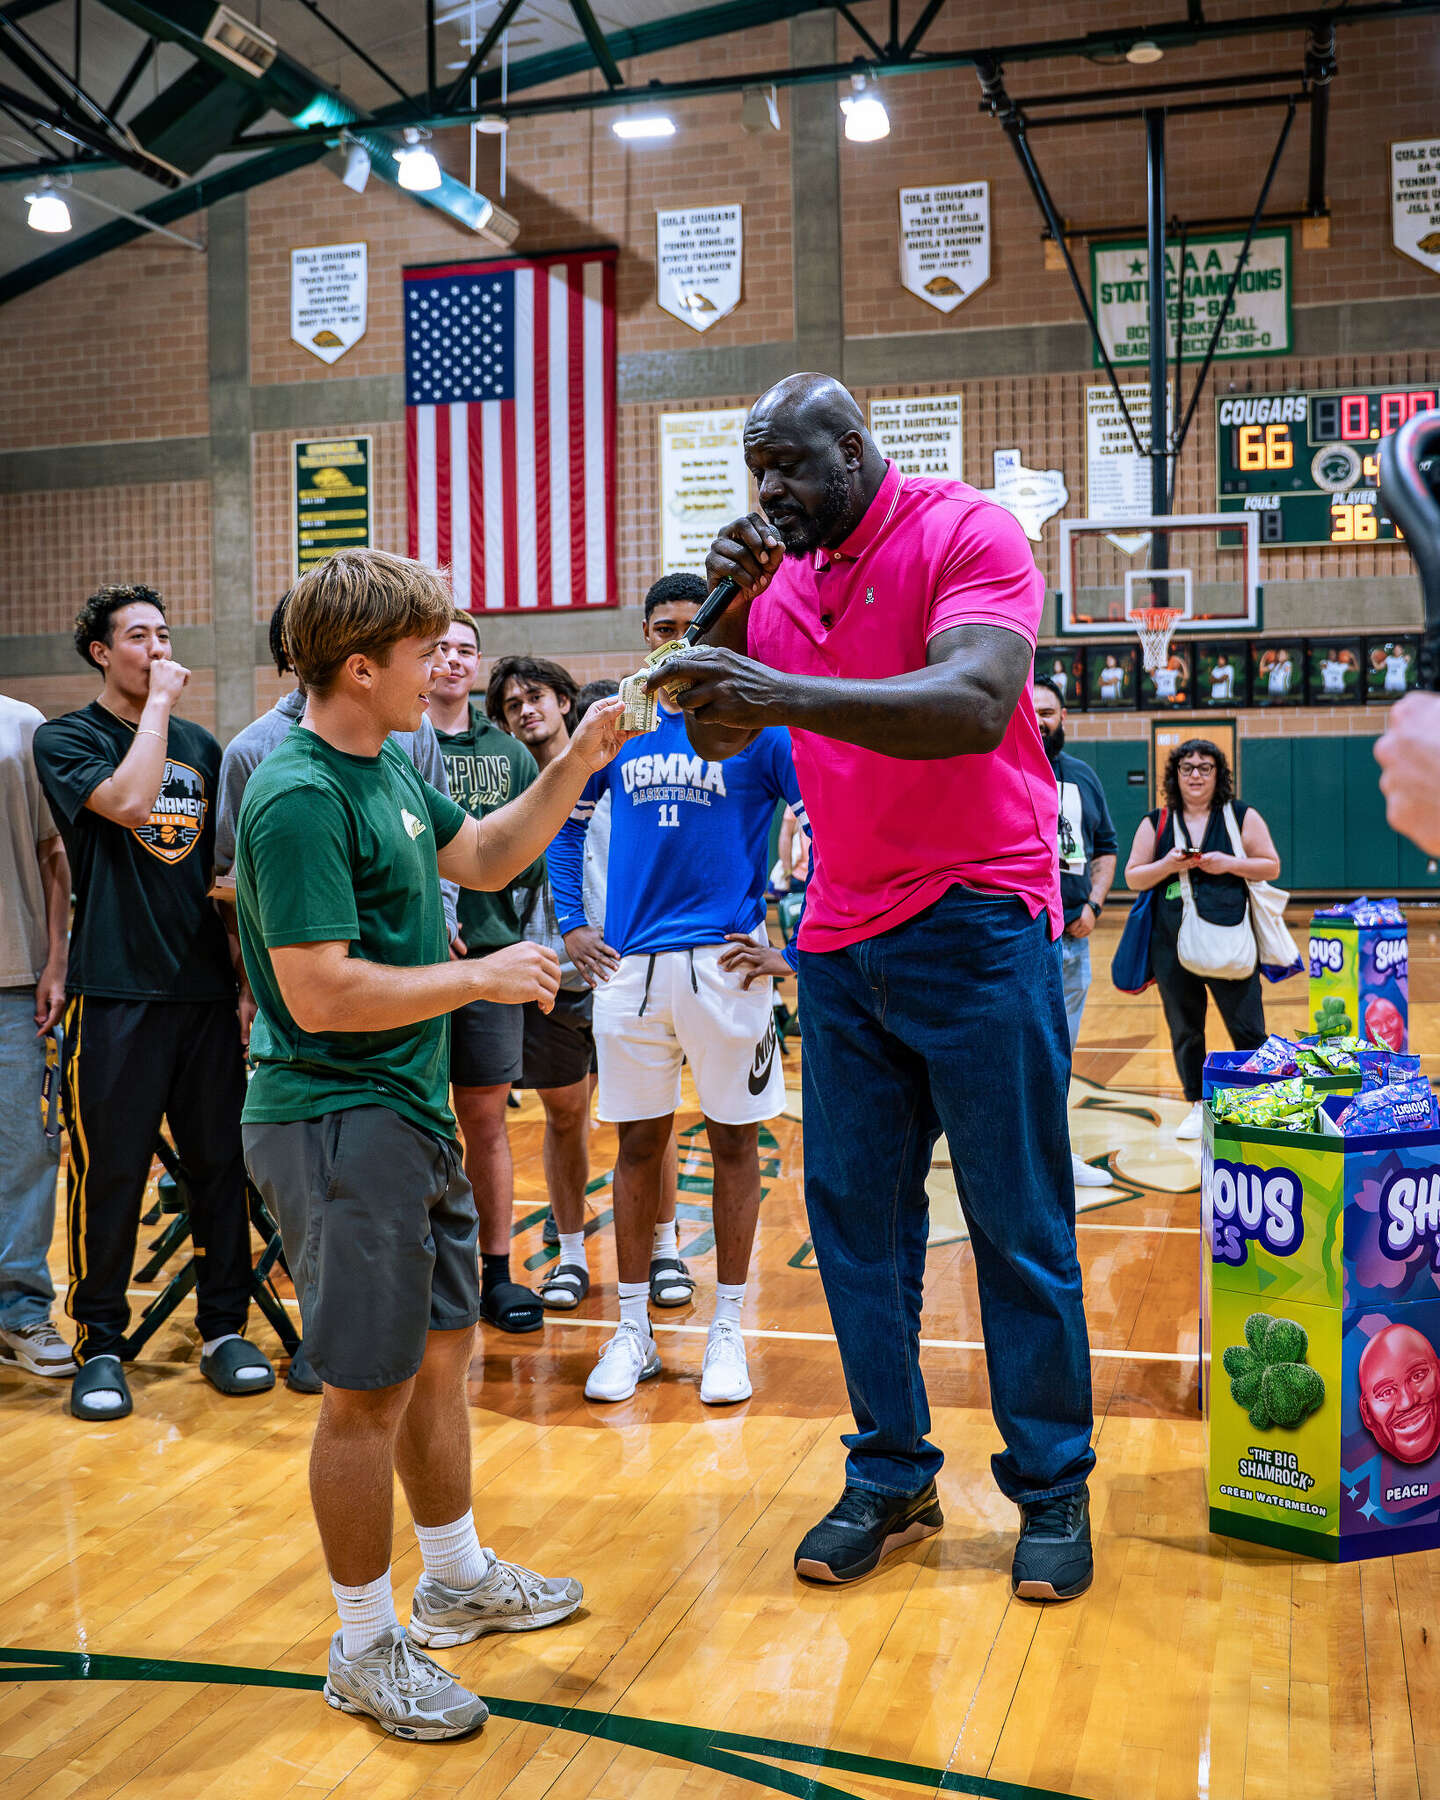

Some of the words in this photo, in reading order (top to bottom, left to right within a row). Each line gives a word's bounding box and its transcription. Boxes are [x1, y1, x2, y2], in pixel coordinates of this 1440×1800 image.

[1395, 149, 1425, 161] COLE
[904, 194, 930, 204] COLE
[934, 189, 983, 202] COUGARS
[905, 401, 958, 413] COUGARS
[1220, 396, 1307, 426] COUGARS
[881, 432, 951, 445] CHAMPIONS
[1239, 424, 1294, 472] 66
[899, 464, 921, 473] ASS
[925, 462, 949, 472] AAA
[1244, 494, 1282, 511] FOULS
[1332, 490, 1378, 506] PLAYER
[1331, 503, 1378, 542] 36
[441, 755, 510, 801] MPIONS
[621, 753, 727, 797] USMMA
[468, 791, 499, 811] quit
[633, 786, 712, 807] BASKETBALL
[152, 796, 206, 818] NAMENT
[658, 803, 680, 827] 11
[1274, 1451, 1297, 1470] BIG
[1220, 1485, 1253, 1500] GREEN
[1256, 1491, 1327, 1518] WATERMELON
[1386, 1484, 1429, 1502] PEACH
